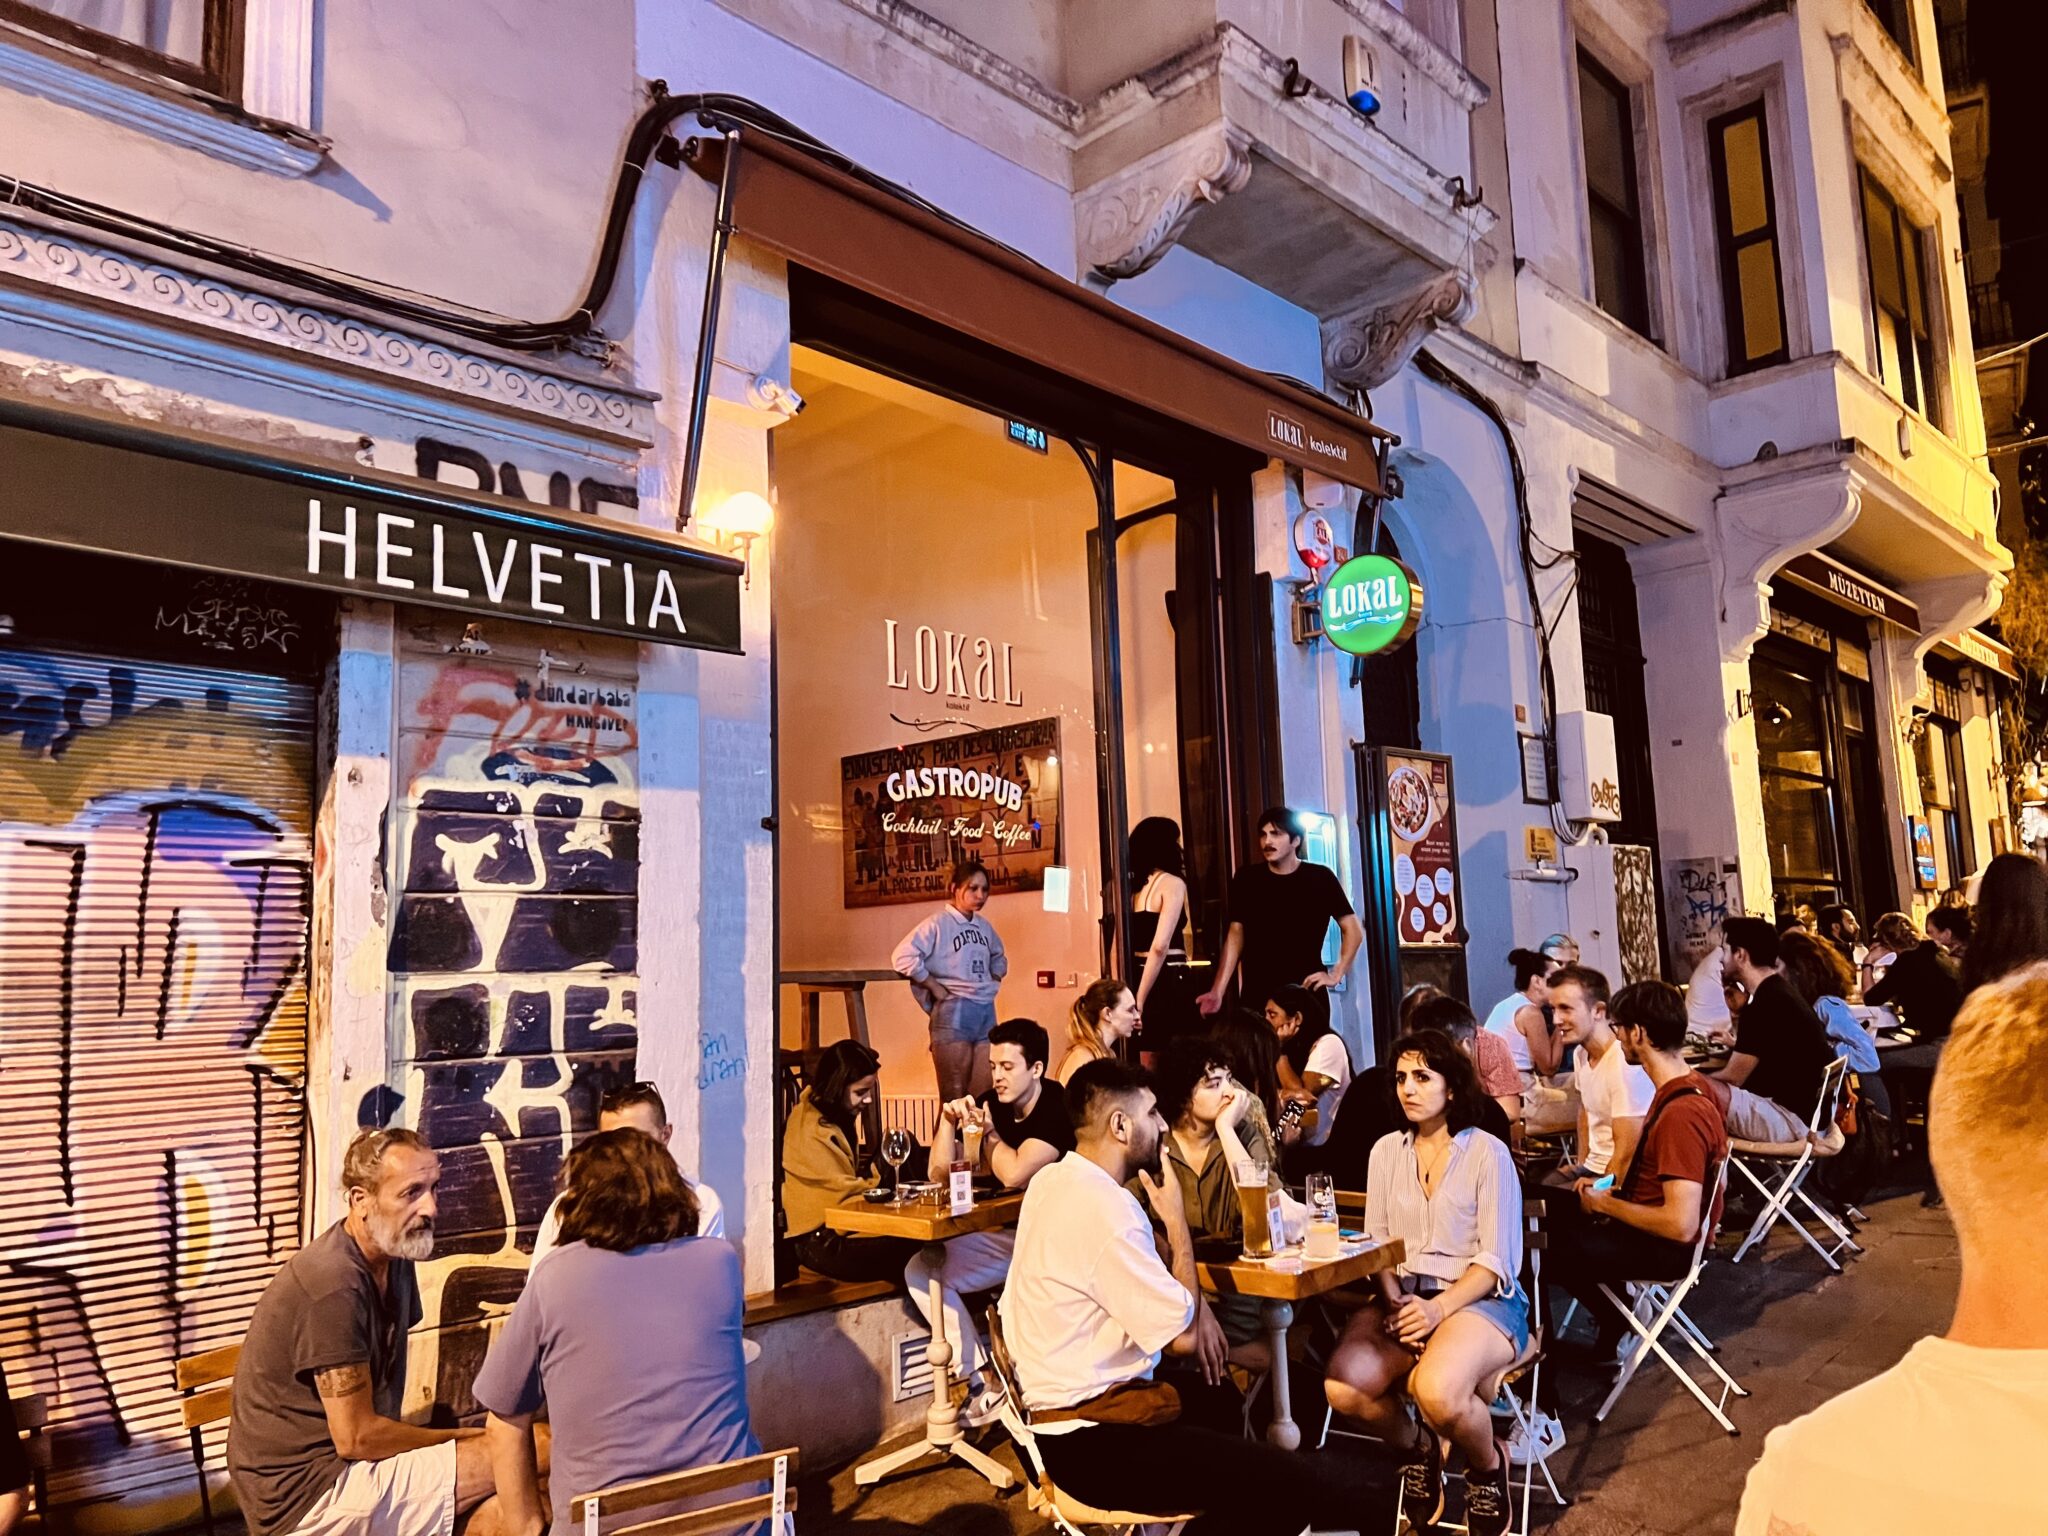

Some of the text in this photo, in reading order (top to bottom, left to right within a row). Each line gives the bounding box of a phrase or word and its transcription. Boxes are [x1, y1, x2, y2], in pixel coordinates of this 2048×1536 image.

[1309, 435, 1347, 461] kolektif
[307, 498, 687, 634] HELVETIA
[1827, 570, 1887, 614] MÜZEYYEN
[886, 766, 1023, 813] GASTROPUB
[881, 812, 1032, 848] Cocktail Food Coffee
